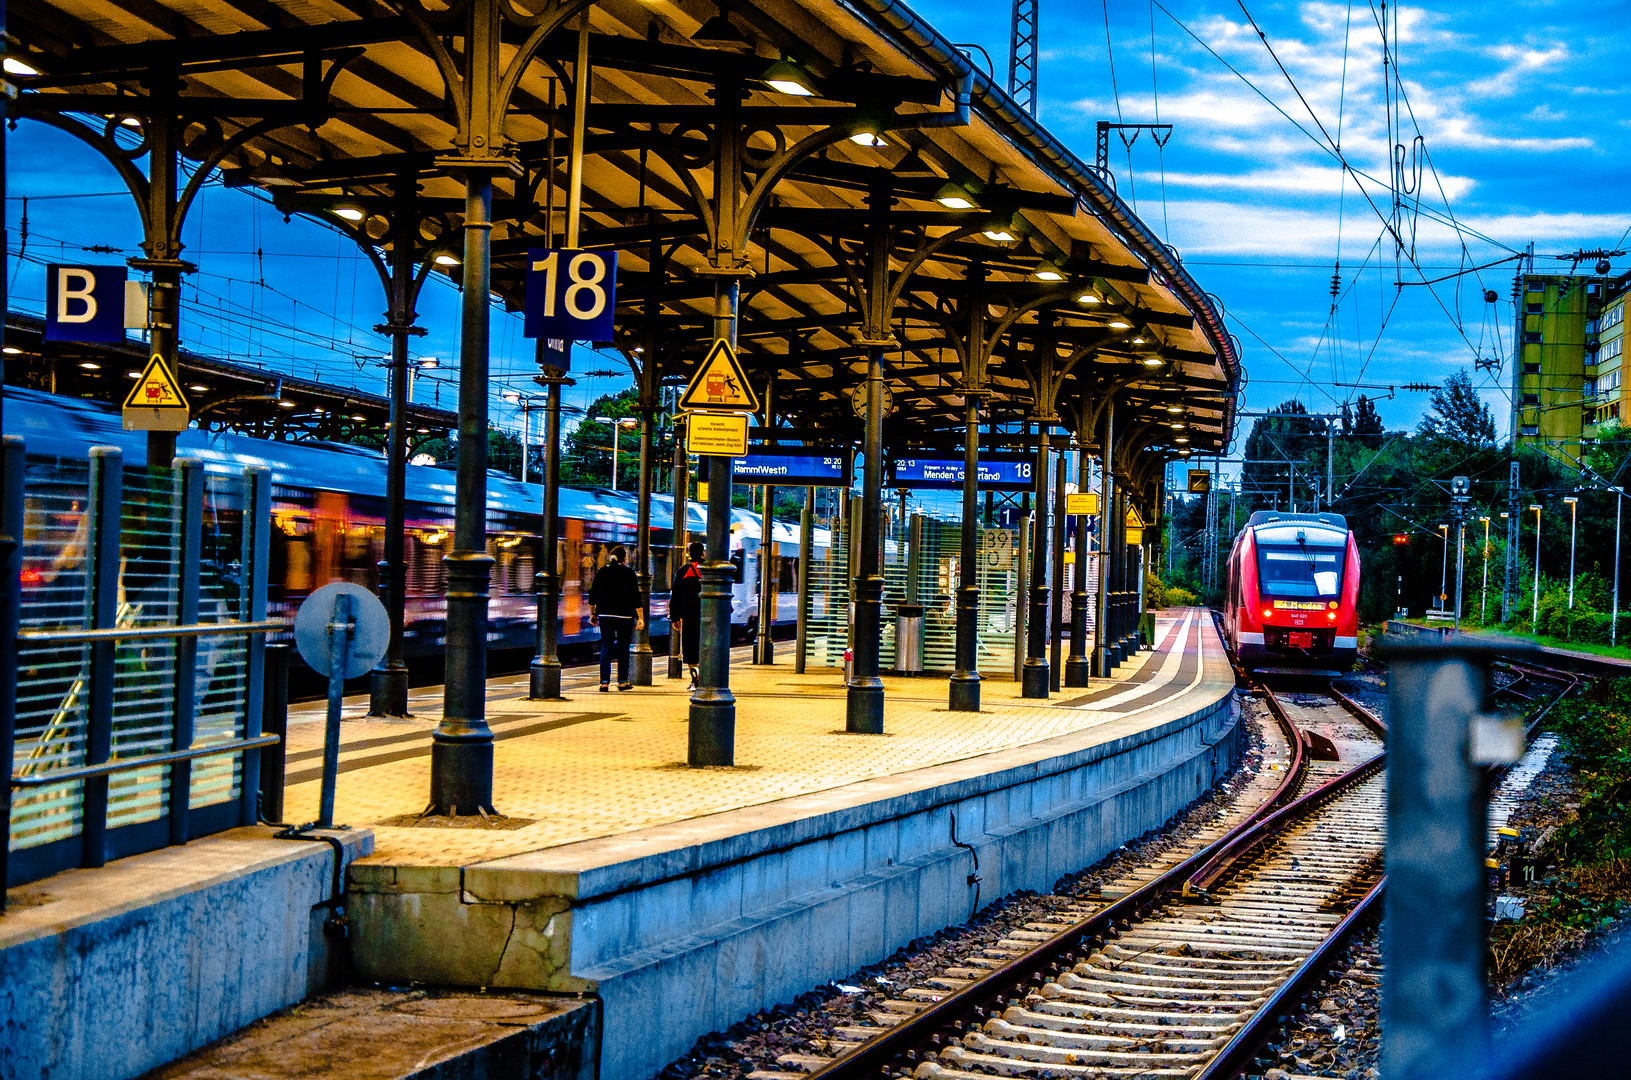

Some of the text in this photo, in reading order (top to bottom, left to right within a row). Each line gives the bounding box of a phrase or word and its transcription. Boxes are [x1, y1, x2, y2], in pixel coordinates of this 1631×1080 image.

[532, 252, 606, 320] 18
[57, 268, 97, 323] B
[824, 457, 841, 465] 20:20
[924, 471, 955, 480] Menden
[1015, 463, 1032, 478] 18
[1002, 509, 1011, 525] 1
[1522, 865, 1535, 881] 11
